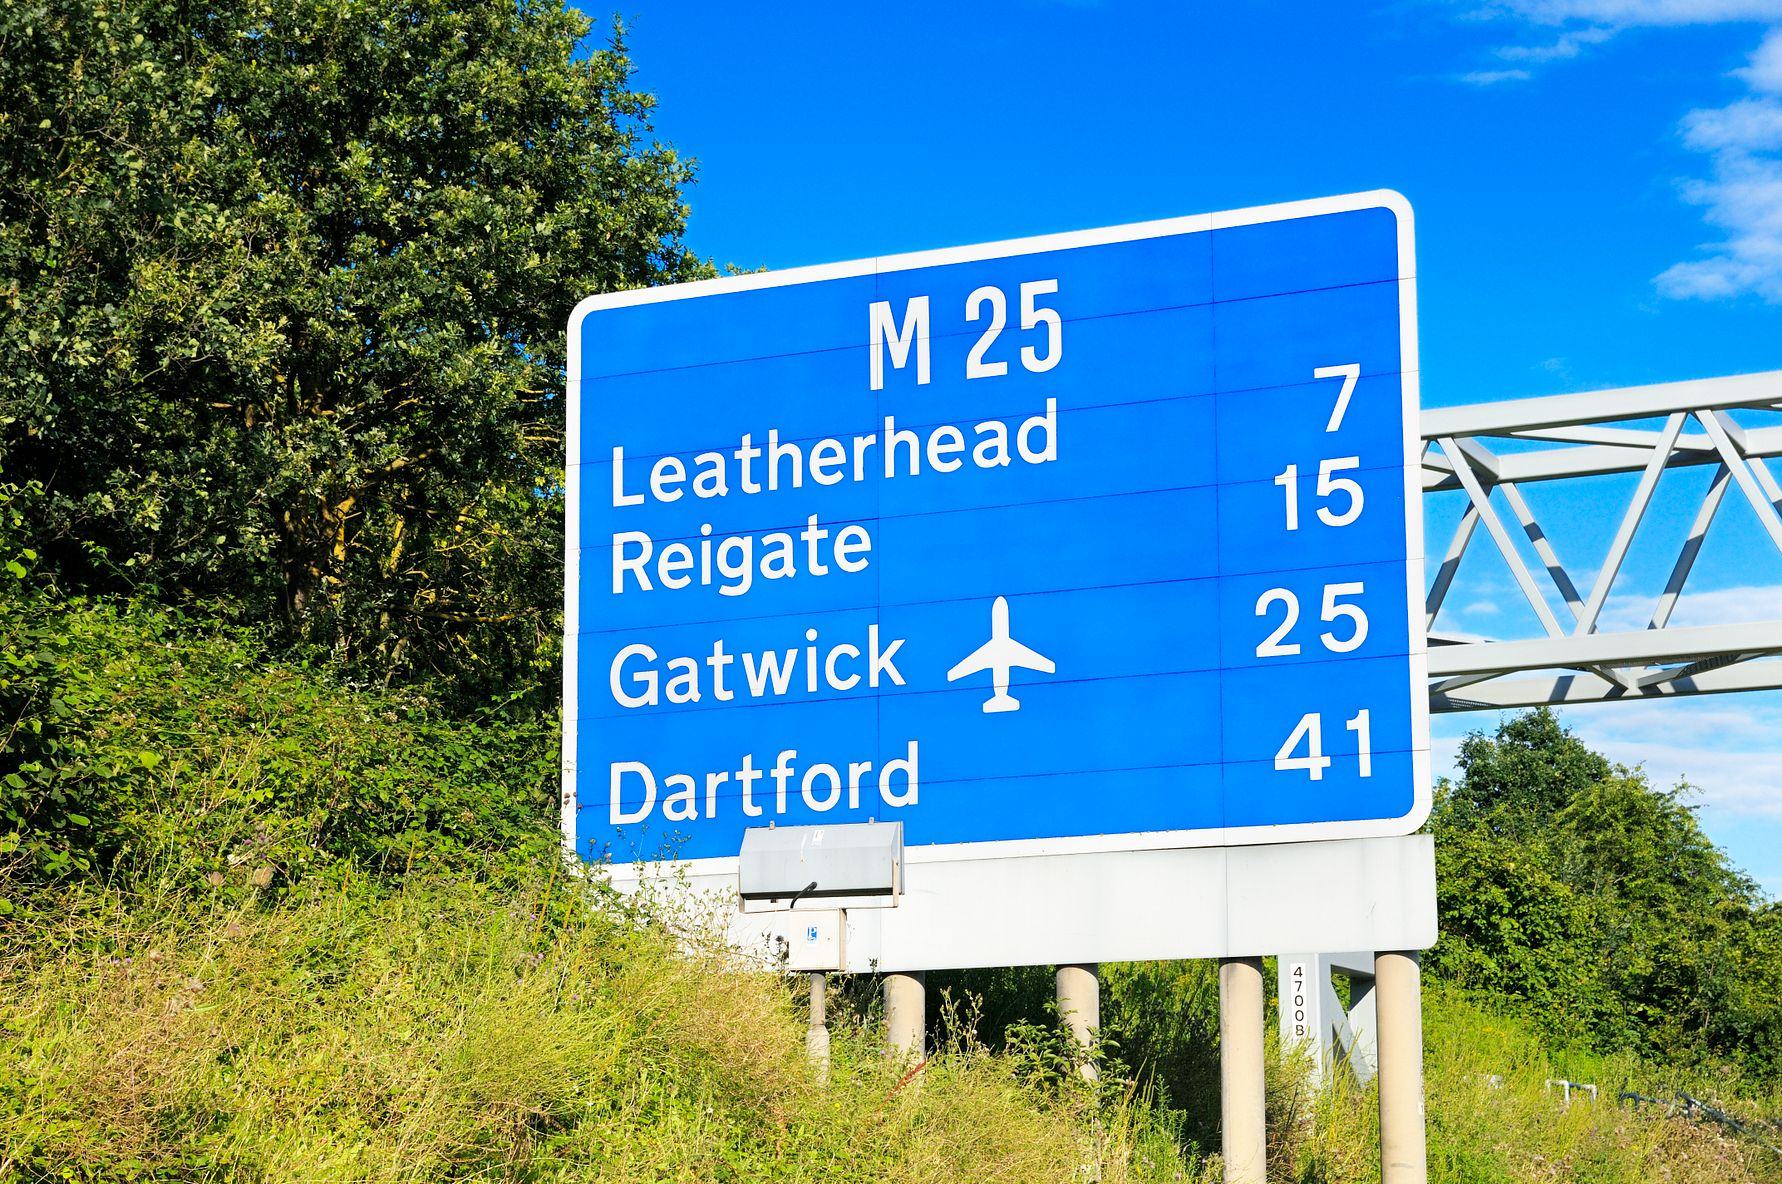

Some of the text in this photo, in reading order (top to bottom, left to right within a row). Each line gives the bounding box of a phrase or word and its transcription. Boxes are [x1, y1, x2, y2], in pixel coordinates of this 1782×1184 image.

[868, 278, 1064, 391] M 25
[611, 363, 1361, 507] Leatherhead 7
[611, 456, 1365, 597] Reigate 15
[608, 581, 1370, 708] Gatwick 25
[608, 709, 1373, 826] Dartford 41
